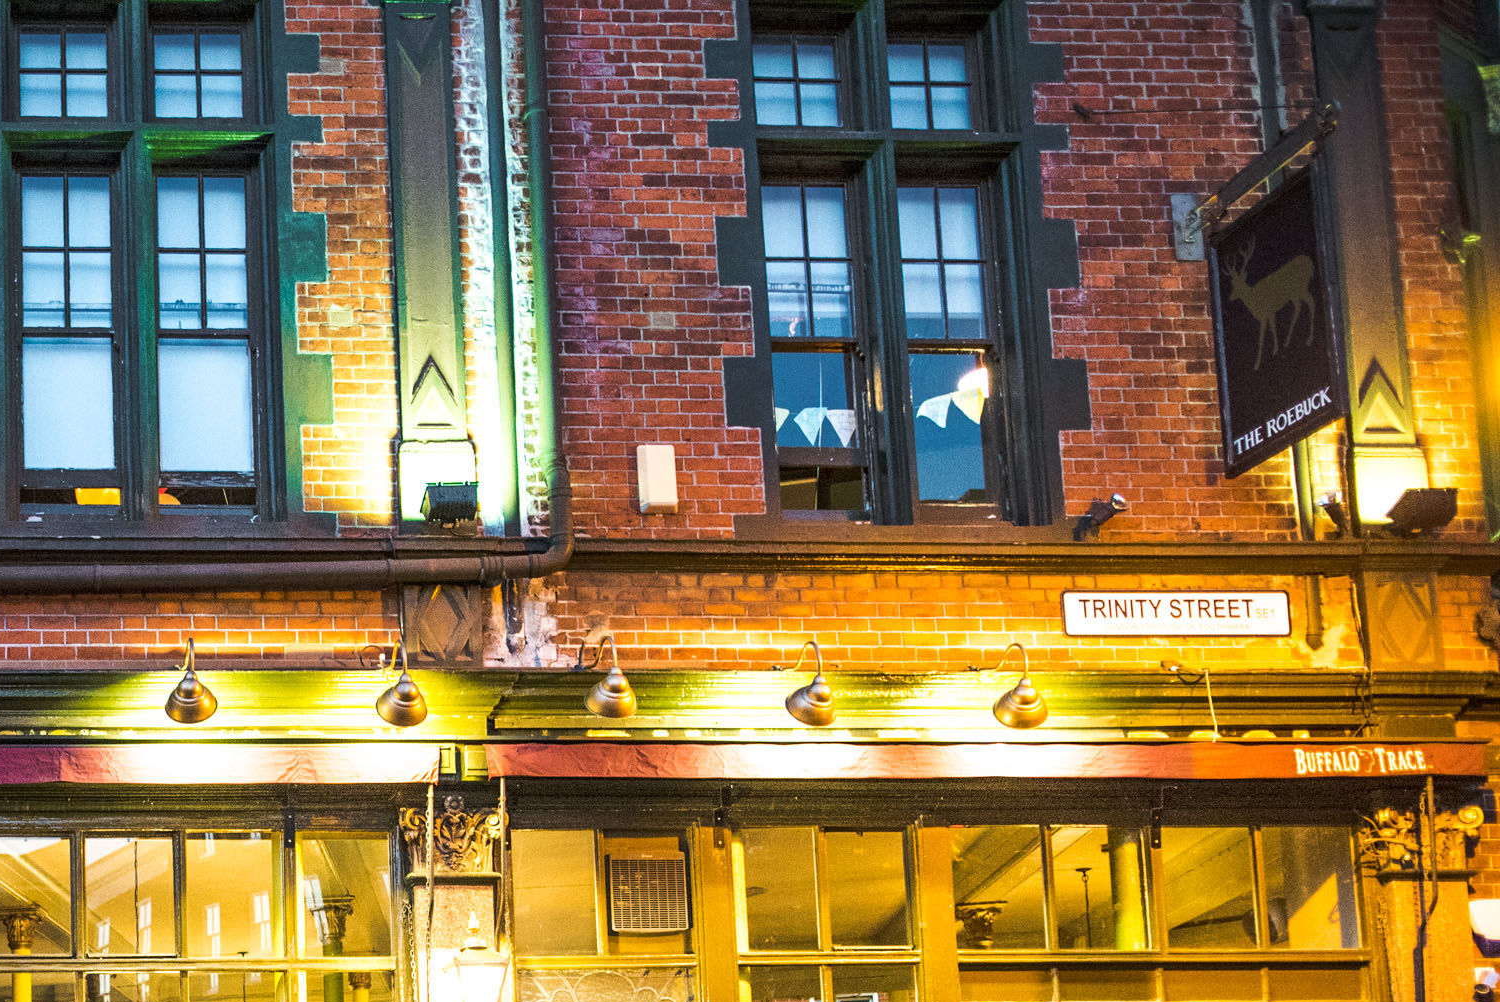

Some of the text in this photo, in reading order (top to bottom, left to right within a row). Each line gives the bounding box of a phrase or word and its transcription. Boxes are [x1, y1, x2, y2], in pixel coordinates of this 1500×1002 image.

[1234, 386, 1332, 455] THE ROEBUCK
[1079, 599, 1276, 619] TRINITY STREET SE1
